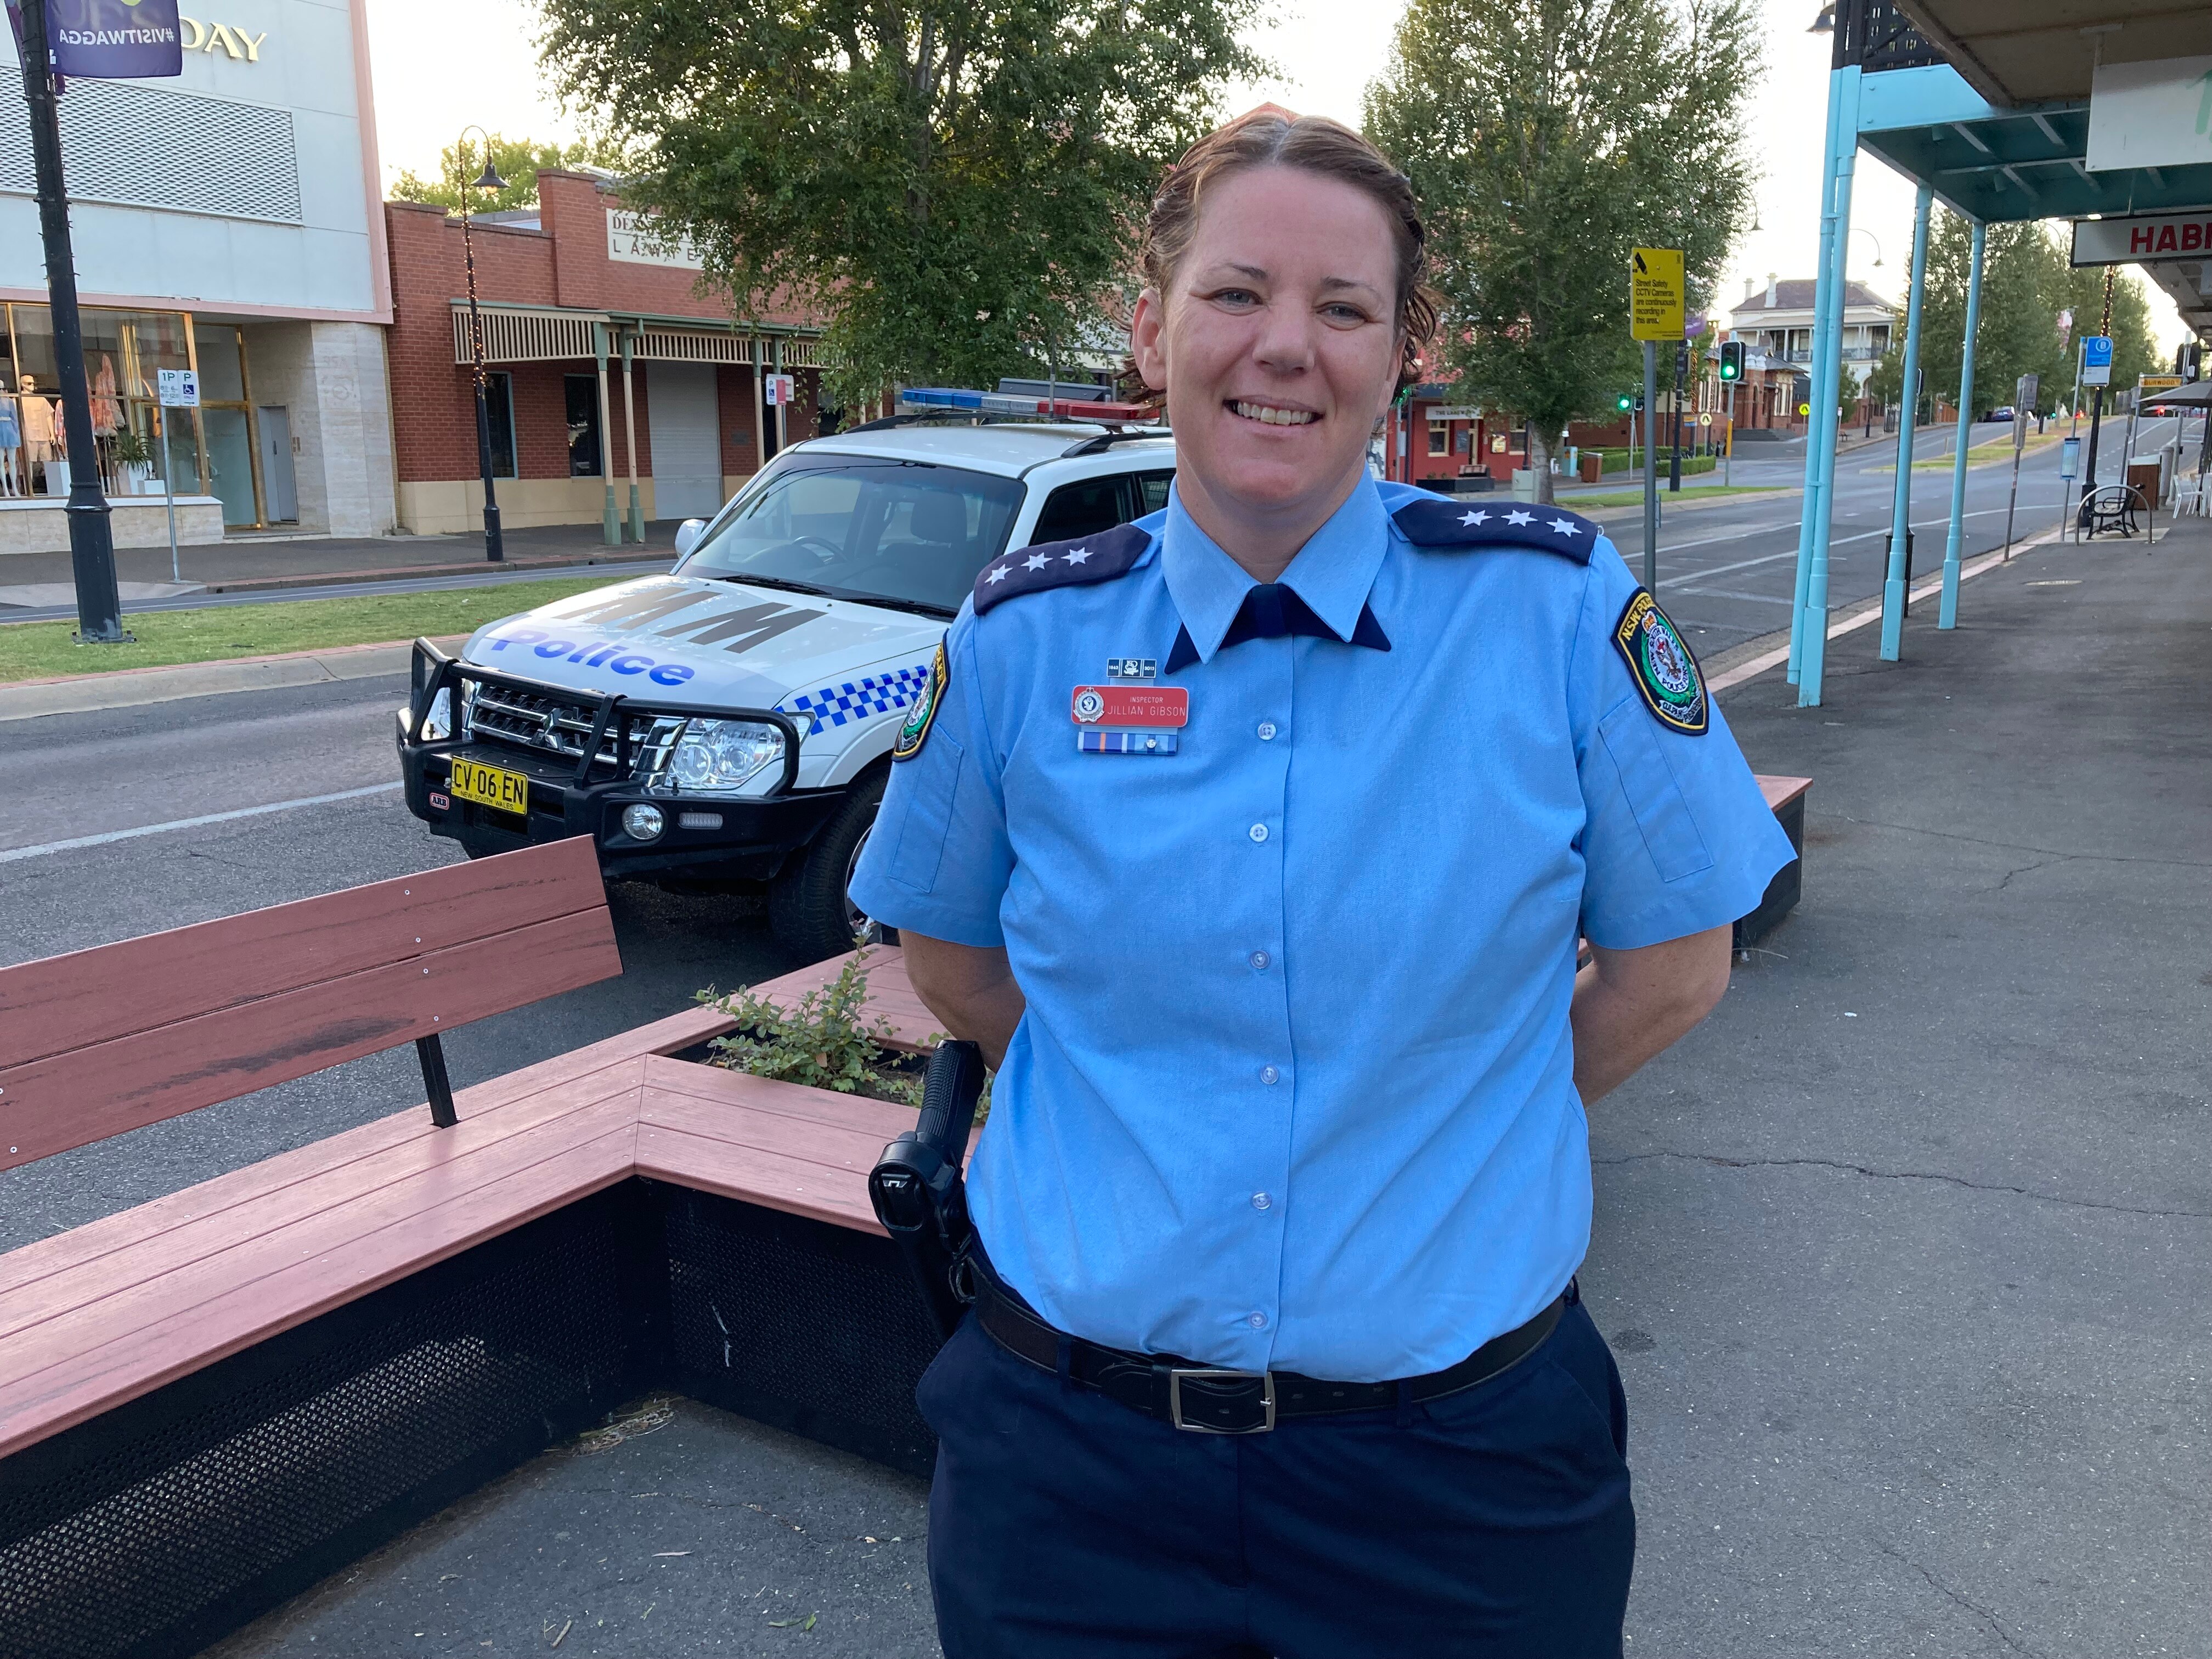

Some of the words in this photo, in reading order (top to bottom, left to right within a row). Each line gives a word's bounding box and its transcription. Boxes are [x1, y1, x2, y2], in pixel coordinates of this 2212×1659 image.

[1635, 279, 1651, 287] Street
[1652, 279, 1668, 289] Safety
[1651, 289, 1674, 297] Cameras
[1645, 298, 1677, 307] continuously
[1635, 307, 1660, 317] recording
[162, 372, 175, 381] 1P
[184, 373, 191, 381] P
[491, 629, 696, 686] Police
[1107, 706, 1143, 715] JILLIAN
[1150, 706, 1186, 716] GIBSON
[432, 796, 447, 806] ARB
[460, 790, 472, 799] NEW
[475, 794, 493, 805] SOUTH
[495, 799, 514, 810] WALES
